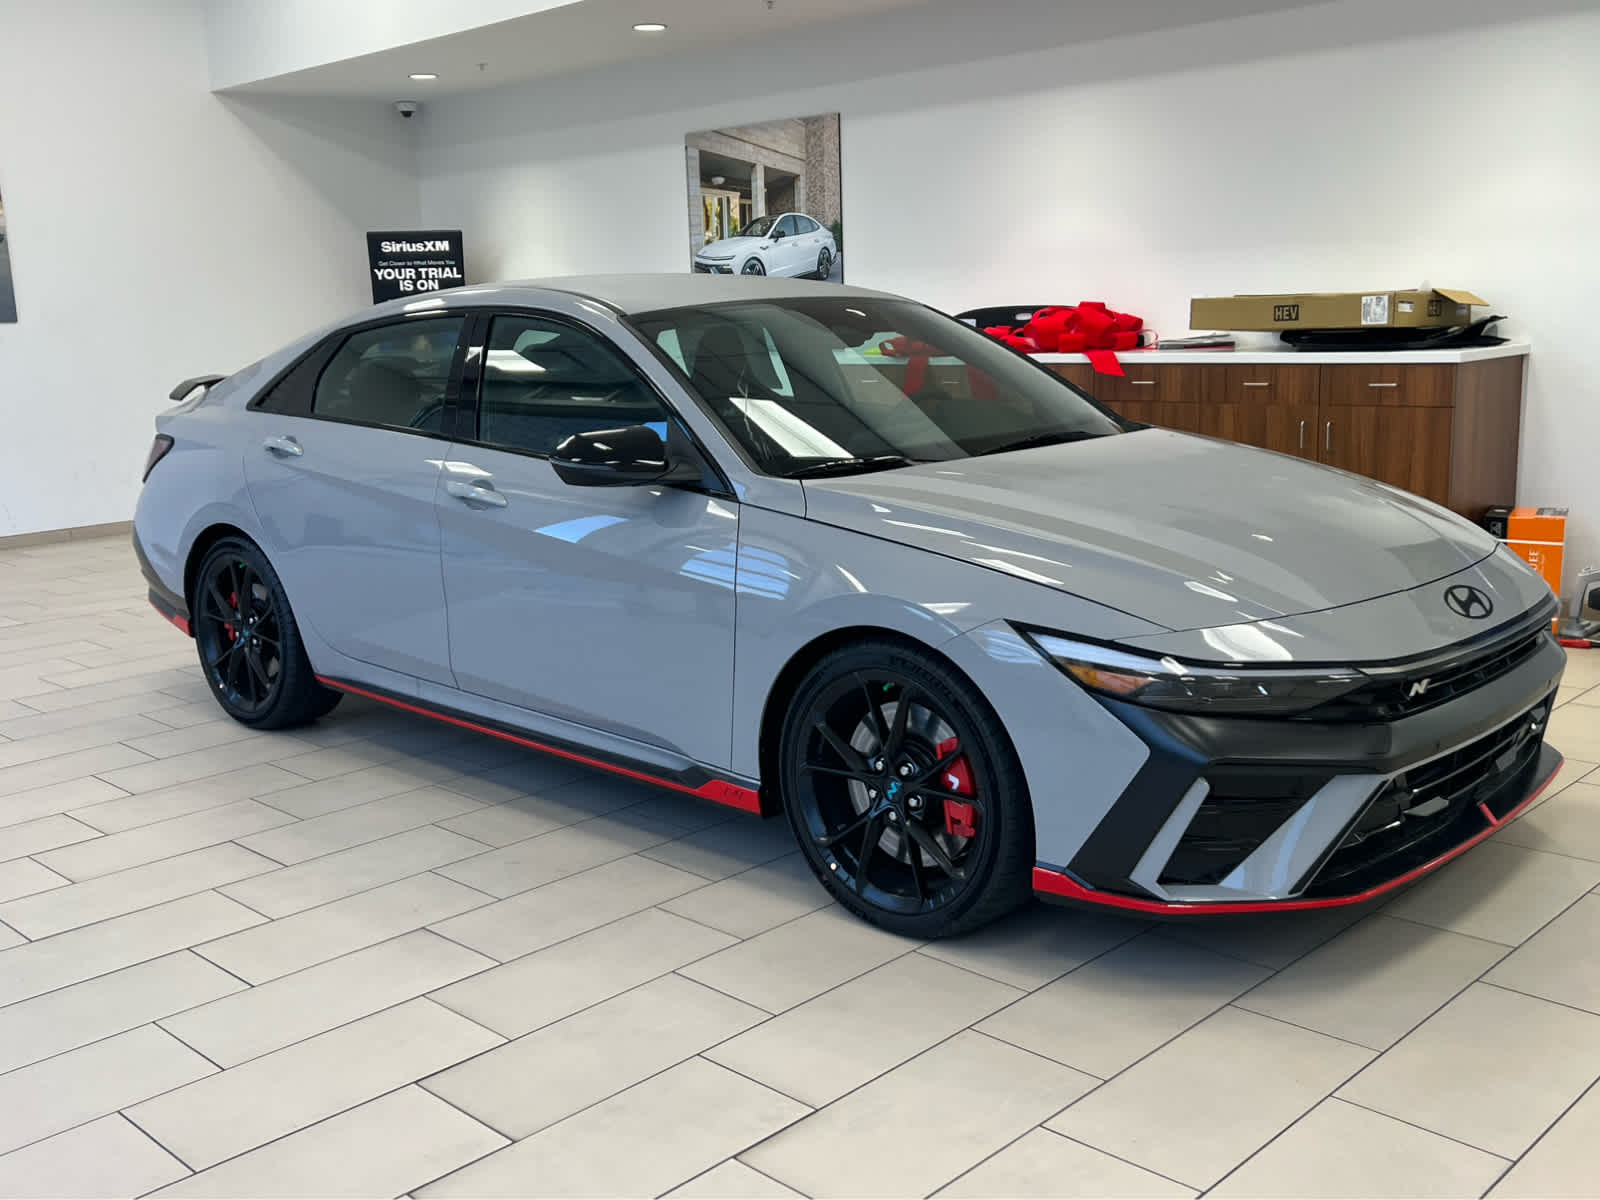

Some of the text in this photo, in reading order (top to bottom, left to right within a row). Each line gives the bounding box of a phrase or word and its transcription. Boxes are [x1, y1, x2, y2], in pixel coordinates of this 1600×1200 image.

[381, 240, 450, 252] SiriusXM
[374, 267, 462, 280] YOUR TRIAL
[400, 280, 439, 291] IS ON
[1275, 306, 1299, 320] HEV
